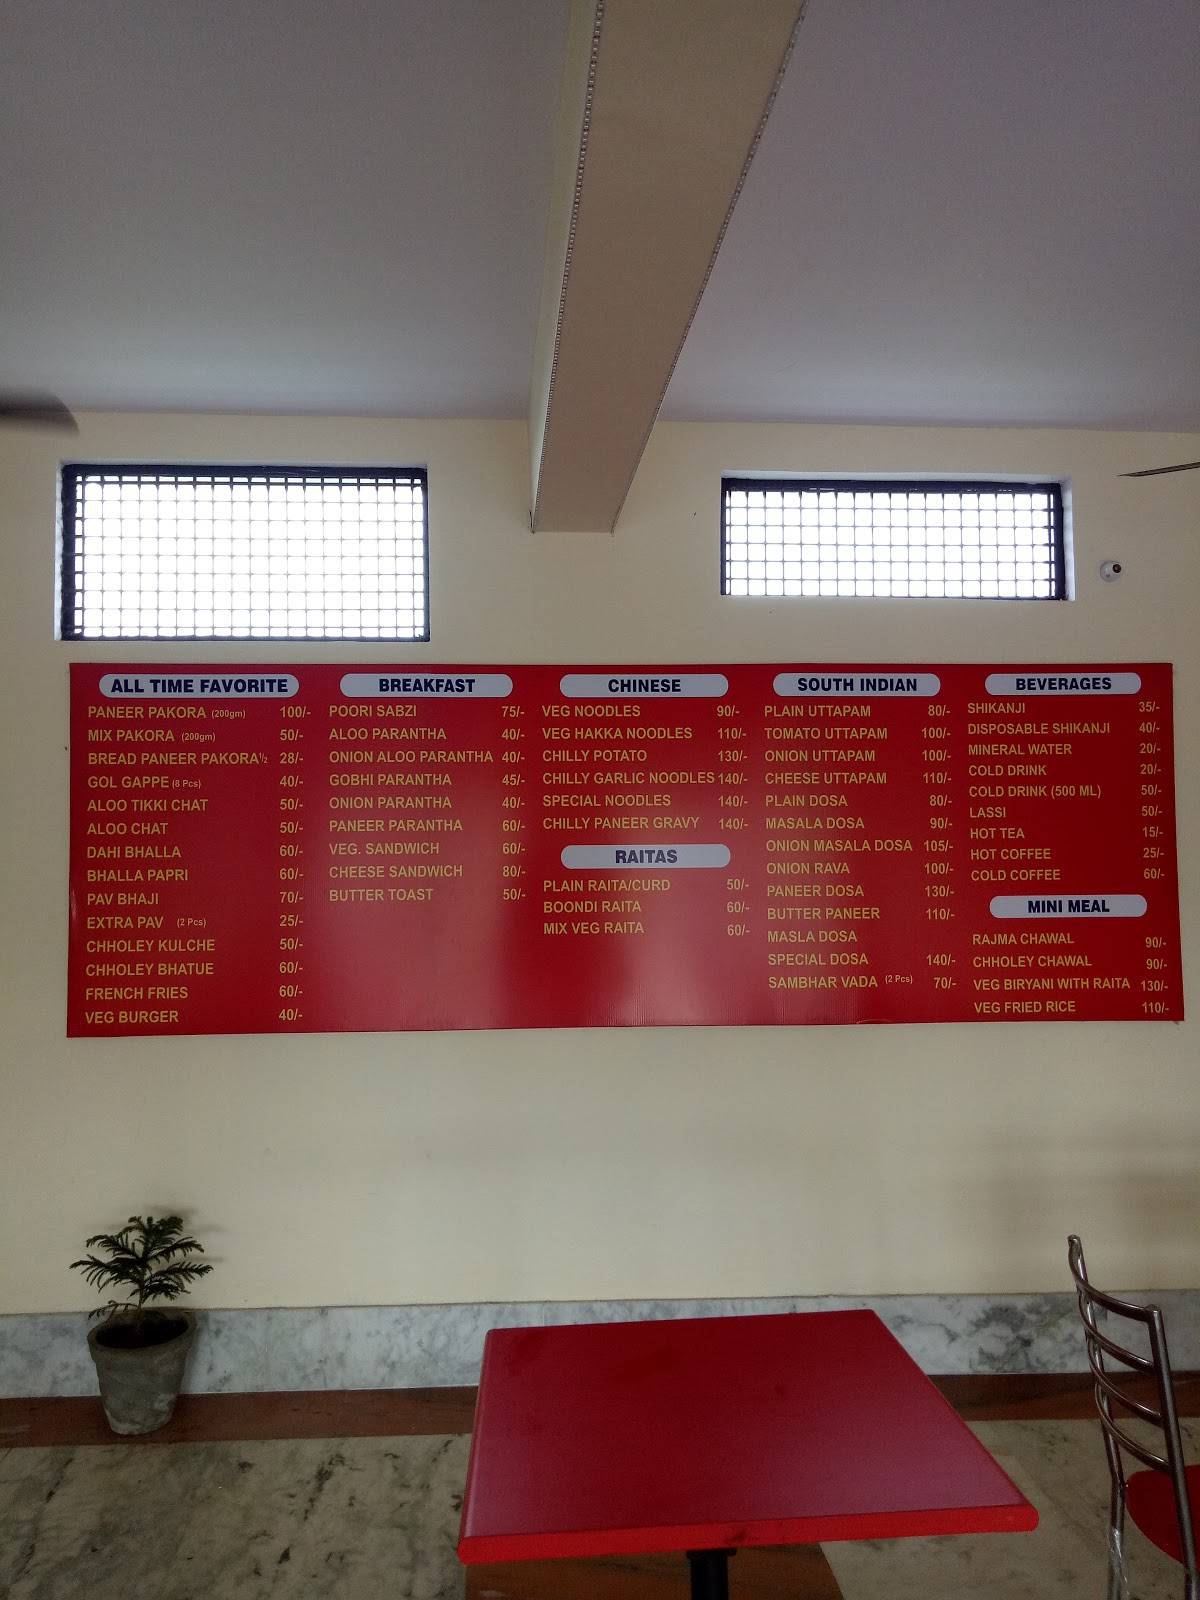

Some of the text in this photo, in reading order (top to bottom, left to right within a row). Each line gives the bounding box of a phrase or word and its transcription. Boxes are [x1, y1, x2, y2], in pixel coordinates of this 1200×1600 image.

[111, 678, 288, 693] ALL TIME FAVORITE
[379, 678, 475, 693] BREAKFAST
[608, 679, 681, 692] CHINESE
[797, 678, 917, 692] SOUTH INDIAN
[1016, 677, 1112, 691] BEVERAGES
[88, 706, 144, 718] PANEER
[149, 707, 207, 718] PAKORA
[280, 706, 311, 718] 100/-
[329, 705, 524, 718] POORI SABZI 75/-
[542, 704, 740, 717] VEG NOODLES 90/-
[765, 705, 950, 718] PLAIN UTTAPAM 80/-
[968, 701, 1160, 713] SHIKANJI 35/-
[329, 728, 525, 740] ALOO PARANTHA 40/-
[542, 727, 746, 740] VEG HAKKA NOODLES 110/-
[764, 727, 951, 739] TOMATO UTTAPAM 100/-
[968, 722, 1160, 734] DISPOSABLE SHIKANJI 40/-
[88, 729, 112, 742] MIX
[117, 730, 175, 741] PAKORA
[280, 729, 303, 741] 50/-
[968, 742, 1160, 755] MINERAL WATER 20/-
[329, 751, 525, 763] ONION ALOO PARANTHA 40/-
[543, 750, 747, 762] CHILLY POTATO 130/-
[88, 776, 117, 788] GOL
[122, 776, 169, 788] GAPPE
[280, 776, 303, 787] 40/-
[765, 772, 951, 784] CHEESE UTTAPAM 110/-
[969, 784, 1162, 800] COLD DRINK (500 ML) 50/-
[87, 798, 303, 811] ALOO TIKKI CHAT 50/-
[543, 795, 748, 807] SPECIAL NOODLES 140/-
[970, 805, 1162, 818] LASSI 50/-
[330, 819, 525, 832] PANEER PARANTHA 60/-
[543, 816, 748, 830] CHILLY PANEER GRAVY 140/-
[766, 817, 952, 830] MASALA DOSA 90/-
[970, 826, 1163, 839] HOT TEA 15/-
[87, 844, 303, 858] DAHI BHALLA 60/-
[329, 842, 525, 855] VEG. SANDWICH 60/-
[766, 840, 953, 852] ONION MASALA DOSA 105/-
[615, 849, 678, 863] RAITAS
[87, 868, 303, 881] BHALLA PAPRI 60/-
[971, 868, 1164, 881] COLD COFFEE 60/-
[544, 878, 749, 892] PLAIN RAITA/CURD 50/-
[767, 885, 954, 897] PANEER DOSA 130/-
[330, 888, 525, 901] BUTTER TOAST 50/-
[1028, 899, 1110, 913] MINI MEAL
[87, 917, 133, 929] EXTRA
[138, 916, 163, 928] PAV
[280, 914, 303, 926] 25/-
[544, 922, 750, 936] MIX VEG RAITA 60/-
[768, 930, 857, 942] MASLA DOSA
[973, 933, 1166, 948] RAJMA CHAWAL 90/-
[768, 953, 955, 966] SPECIAL DOSA 140/-
[86, 961, 303, 976] CHHOLEY BHATUE 60/-
[769, 976, 837, 988] SAMBHAR
[841, 976, 878, 988] VADA
[934, 977, 956, 989] 70/-
[973, 978, 1168, 991] VEG BIRYANI WITH RAITA 130/-
[974, 1000, 1169, 1013] VEG FRIED RICE 110/-
[85, 1008, 302, 1024] VEG BURGER 40/-
